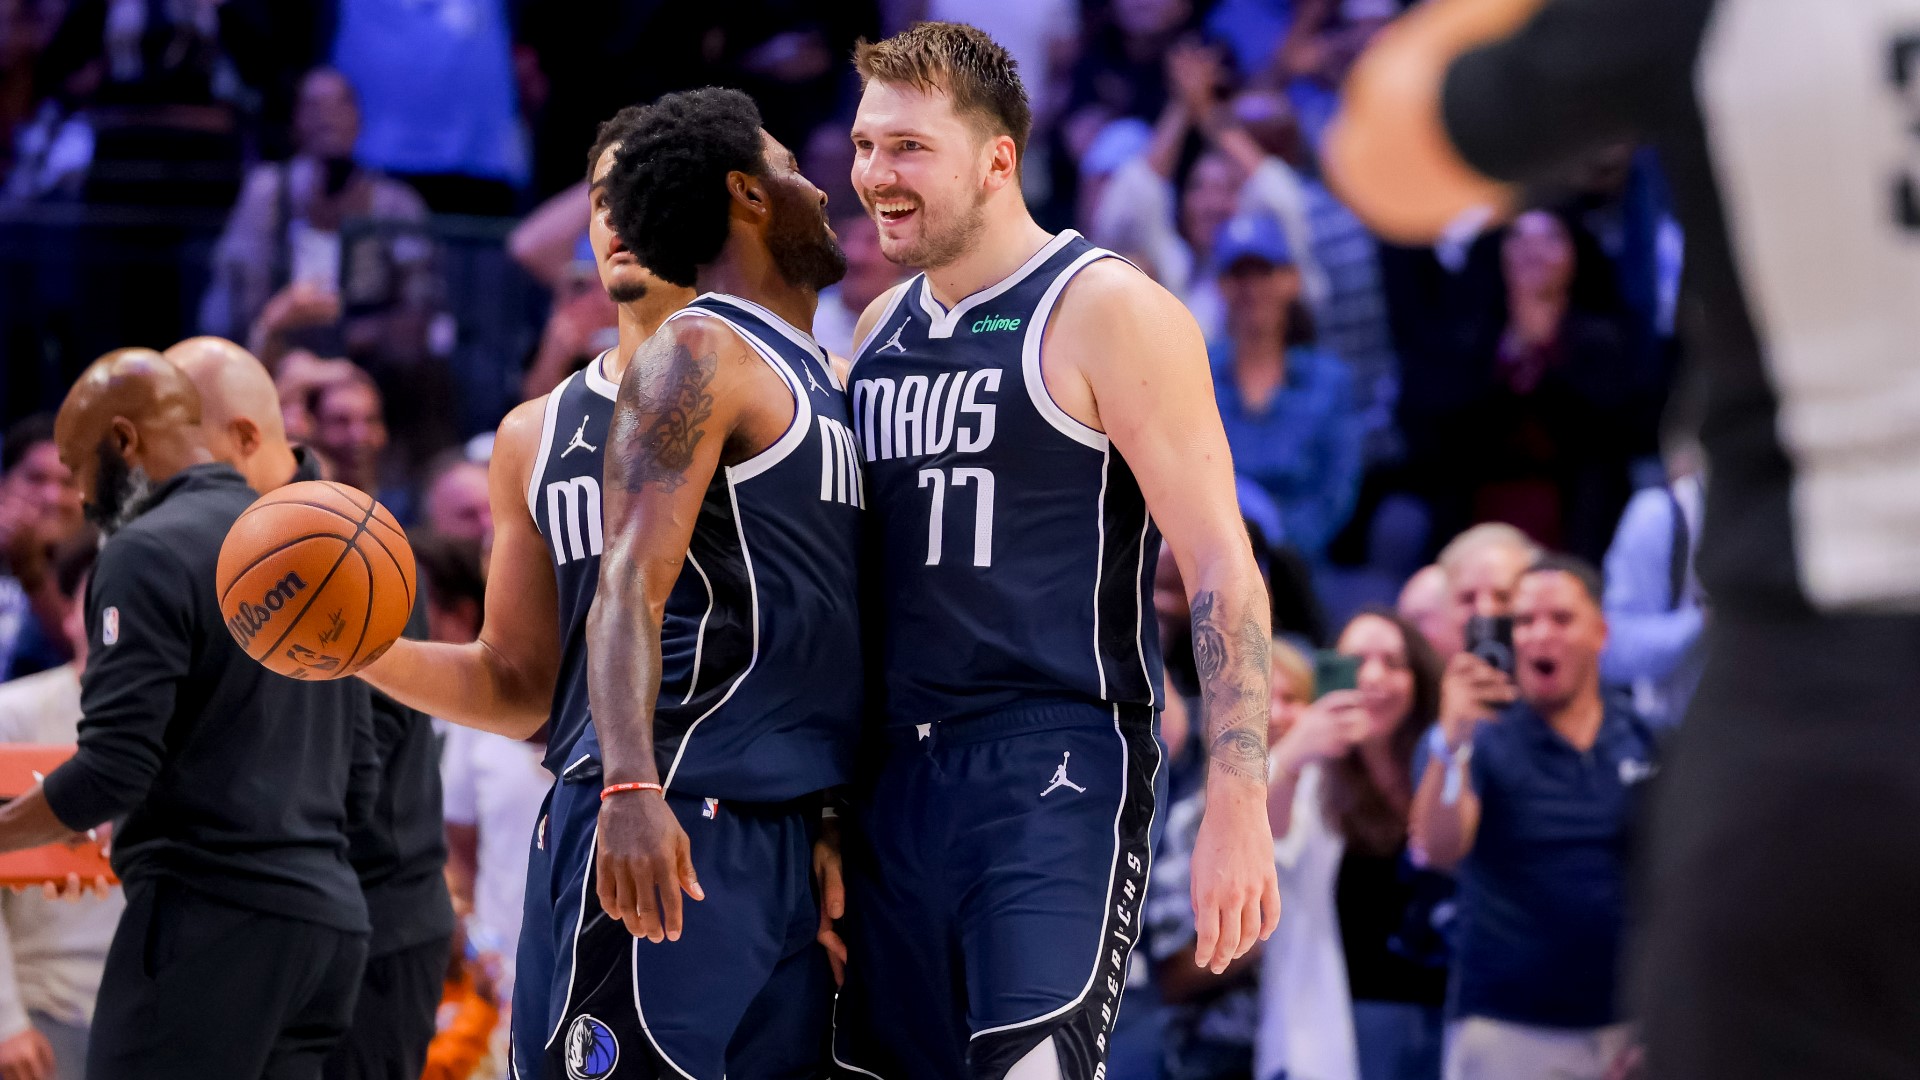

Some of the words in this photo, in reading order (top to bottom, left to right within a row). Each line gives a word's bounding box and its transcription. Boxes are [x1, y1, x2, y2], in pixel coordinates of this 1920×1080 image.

[972, 315, 1022, 334] chime
[854, 368, 1003, 462] MAVS
[918, 468, 995, 567] 77
